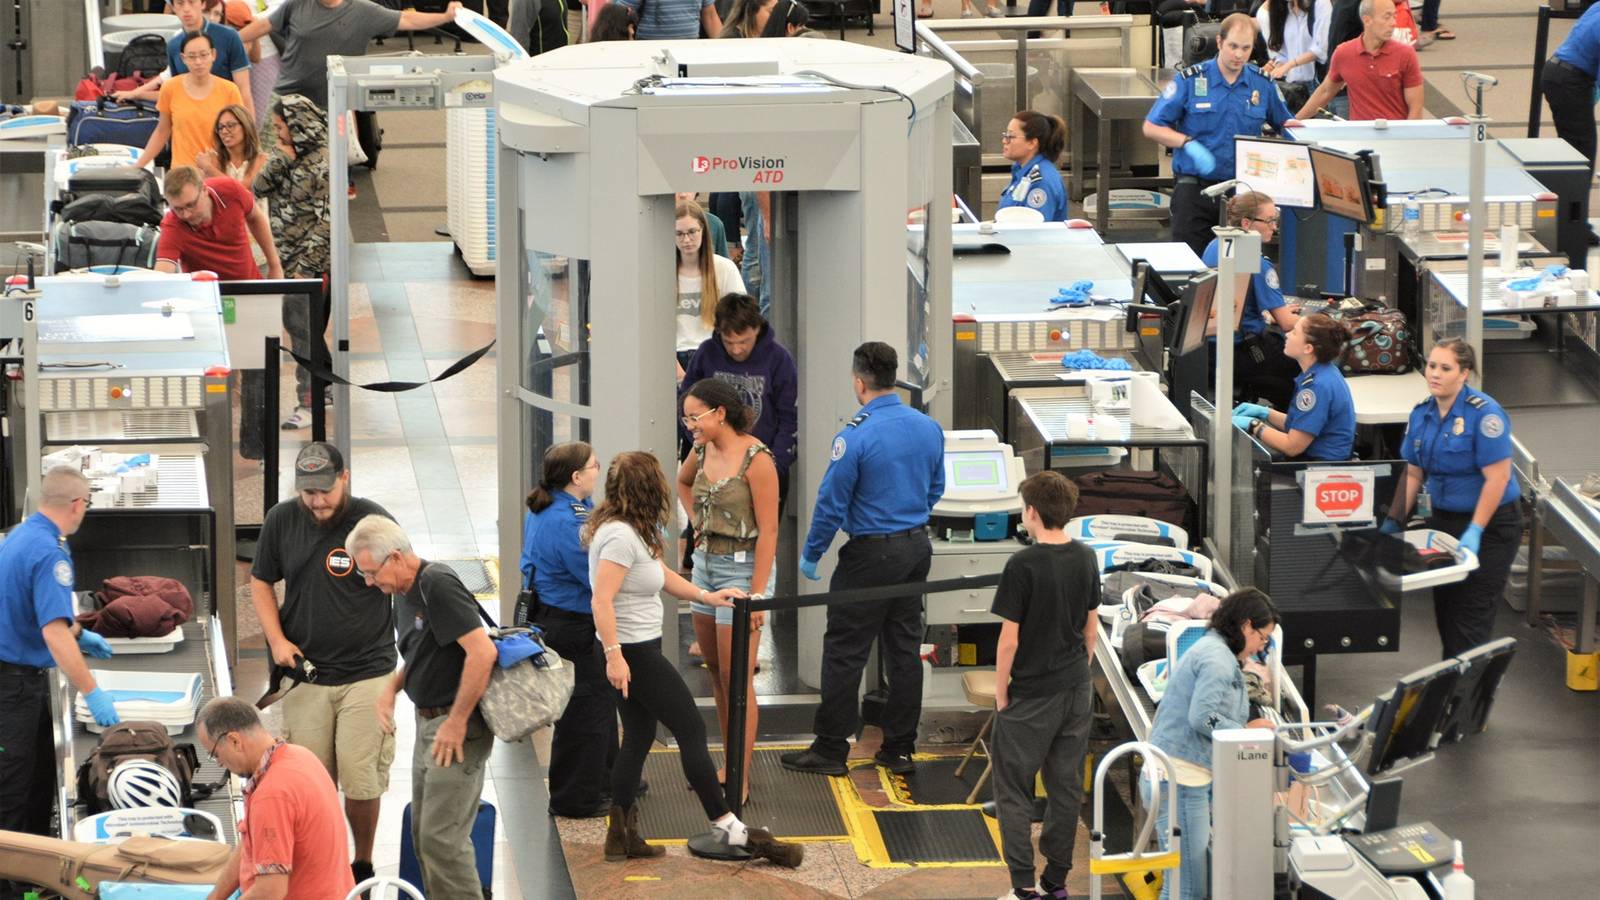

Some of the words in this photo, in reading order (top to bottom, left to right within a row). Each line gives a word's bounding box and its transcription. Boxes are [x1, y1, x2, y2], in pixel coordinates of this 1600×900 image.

[1477, 124, 1485, 141] 8
[712, 156, 785, 169] ProVision
[753, 170, 784, 183] ATD
[1224, 238, 1233, 257] 7
[25, 302, 33, 321] 6
[1320, 489, 1359, 503] STOP
[329, 556, 350, 568] IES
[1237, 751, 1268, 761] iLane
